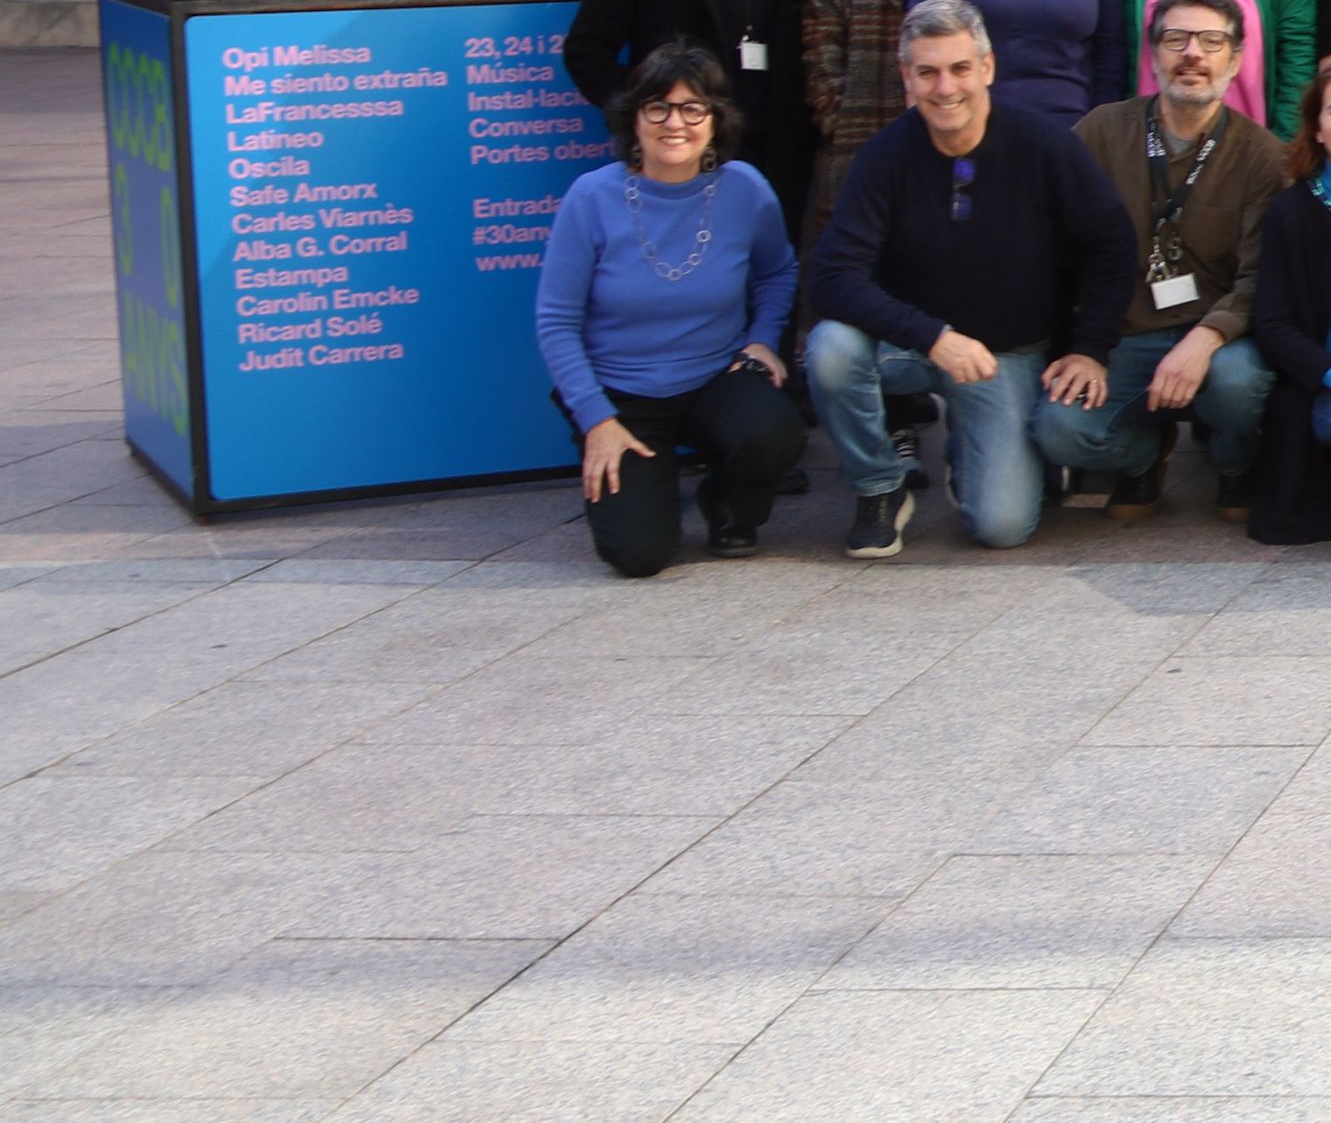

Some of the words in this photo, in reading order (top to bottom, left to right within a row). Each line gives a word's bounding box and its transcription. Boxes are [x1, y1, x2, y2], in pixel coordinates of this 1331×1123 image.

[222, 47, 269, 72] Opi
[273, 45, 371, 66] Melissa
[465, 36, 501, 59] 23,
[504, 36, 533, 56] 24
[537, 35, 545, 54] i
[224, 76, 266, 96] Me
[271, 73, 349, 94] siento
[354, 67, 448, 90] extraña
[466, 61, 554, 85] Música
[226, 99, 403, 124] LaFrancesssa
[227, 129, 324, 152] Latineo
[468, 117, 583, 139] Conversa
[470, 143, 549, 165] Portes
[228, 156, 310, 179] Oscila
[230, 185, 288, 207] Safe
[294, 182, 378, 203] Amorx
[231, 211, 315, 234] Carles
[318, 202, 413, 228] Viarnès
[233, 240, 292, 261] Alba
[296, 236, 324, 257] G.
[329, 231, 408, 255] Corral
[235, 266, 348, 289] Estampa
[235, 292, 328, 316] Carolin
[333, 285, 420, 309] Emcke
[238, 318, 322, 344] Ricard
[326, 311, 382, 337] Solé
[239, 347, 304, 371] Judit
[308, 342, 403, 365] Carrera
